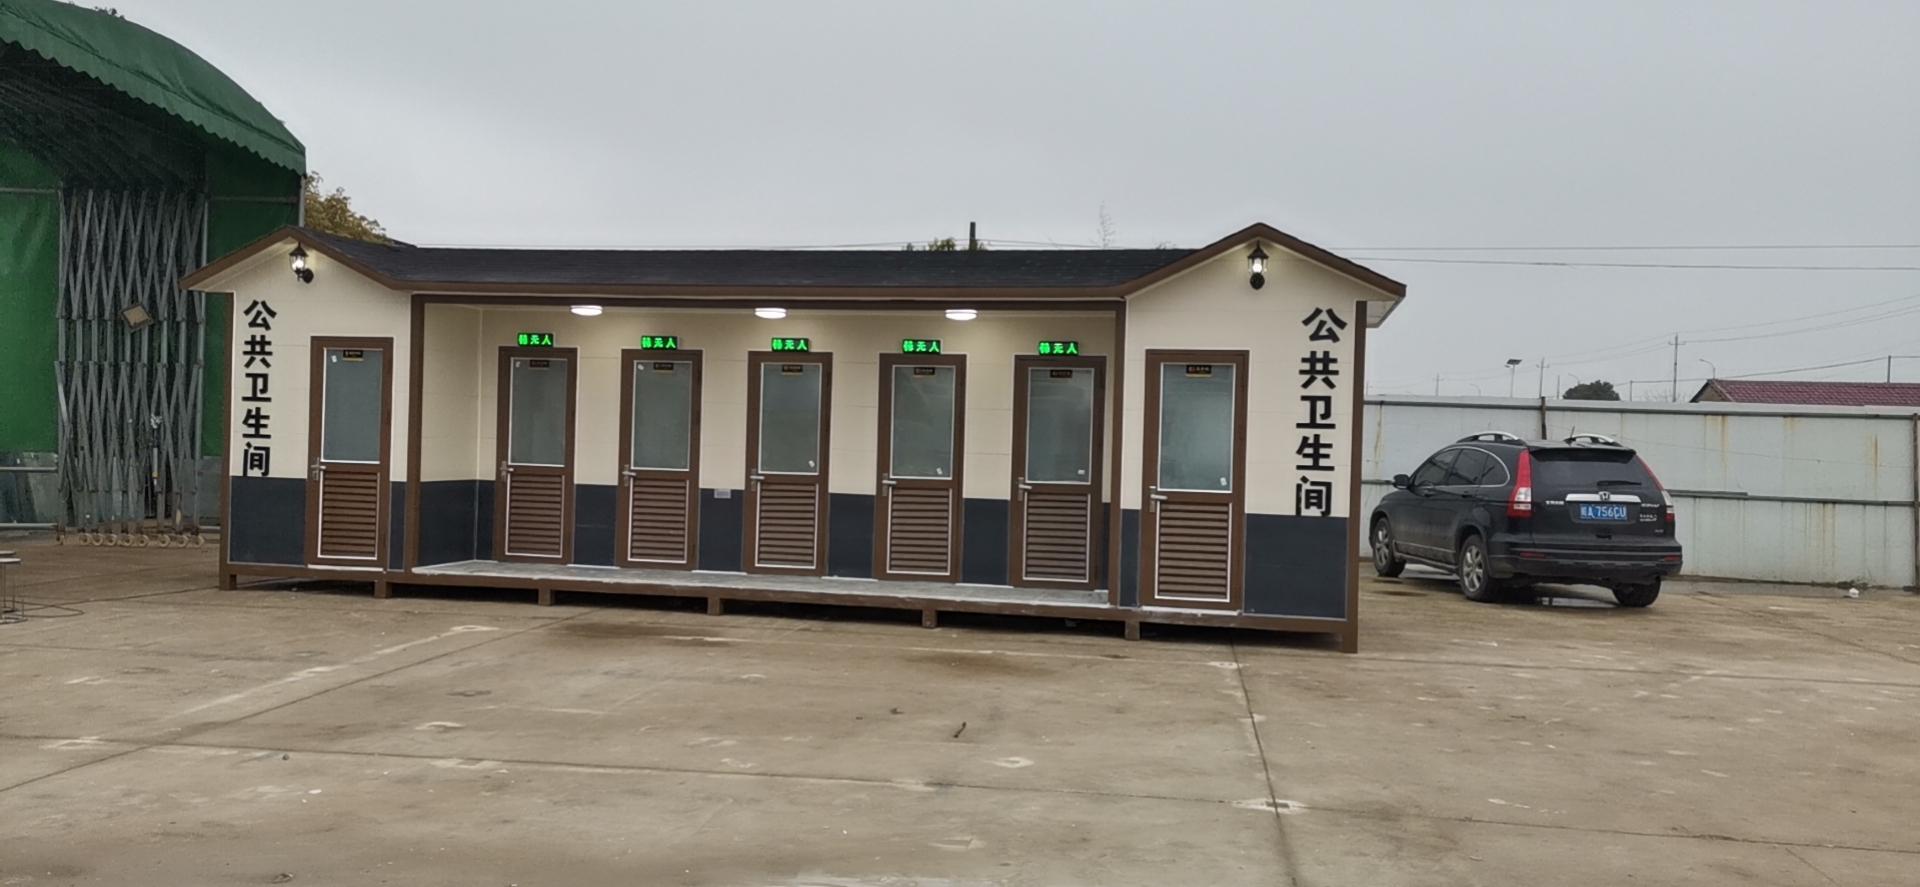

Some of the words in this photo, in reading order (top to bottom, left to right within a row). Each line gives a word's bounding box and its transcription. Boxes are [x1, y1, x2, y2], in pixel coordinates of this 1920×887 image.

[241, 299, 277, 477] 公共卫生间
[1295, 307, 1348, 517] 公共卫生间
